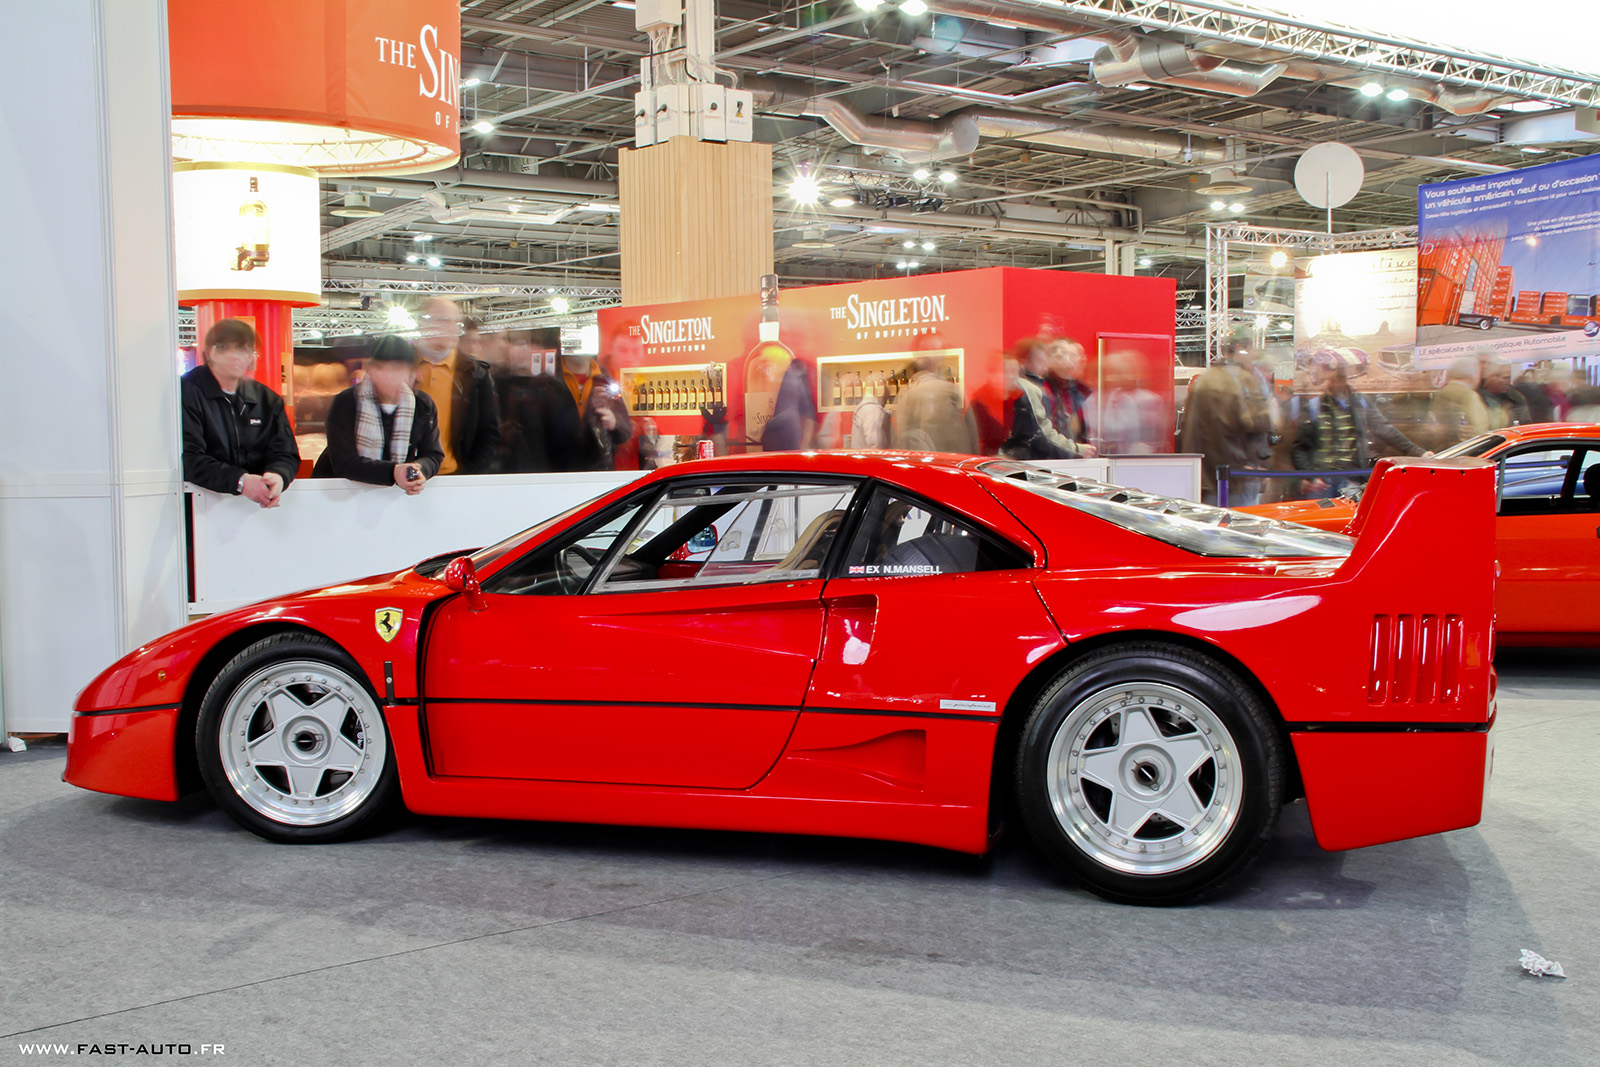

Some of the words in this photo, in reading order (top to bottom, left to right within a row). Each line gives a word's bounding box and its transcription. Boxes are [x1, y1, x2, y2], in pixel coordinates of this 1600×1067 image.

[374, 36, 416, 69] THE
[419, 24, 460, 113] SIN
[435, 111, 450, 129] OF
[1424, 190, 1446, 199] Vous
[1447, 184, 1487, 196] souhaitez
[1488, 177, 1524, 189] importer
[1437, 196, 1472, 207] véhicule
[1517, 183, 1537, 195] neuf
[1538, 183, 1550, 191] ou
[1551, 174, 1598, 189] d'occasion
[829, 306, 847, 319] THE
[628, 325, 641, 336] THE
[856, 331, 868, 340] OF
[875, 327, 936, 339] DUFFTOWN
[1428, 345, 1464, 355] spécialiste
[1524, 336, 1567, 346] Automobile
[866, 565, 880, 574] EX
[883, 565, 943, 575] N.MANSELL
